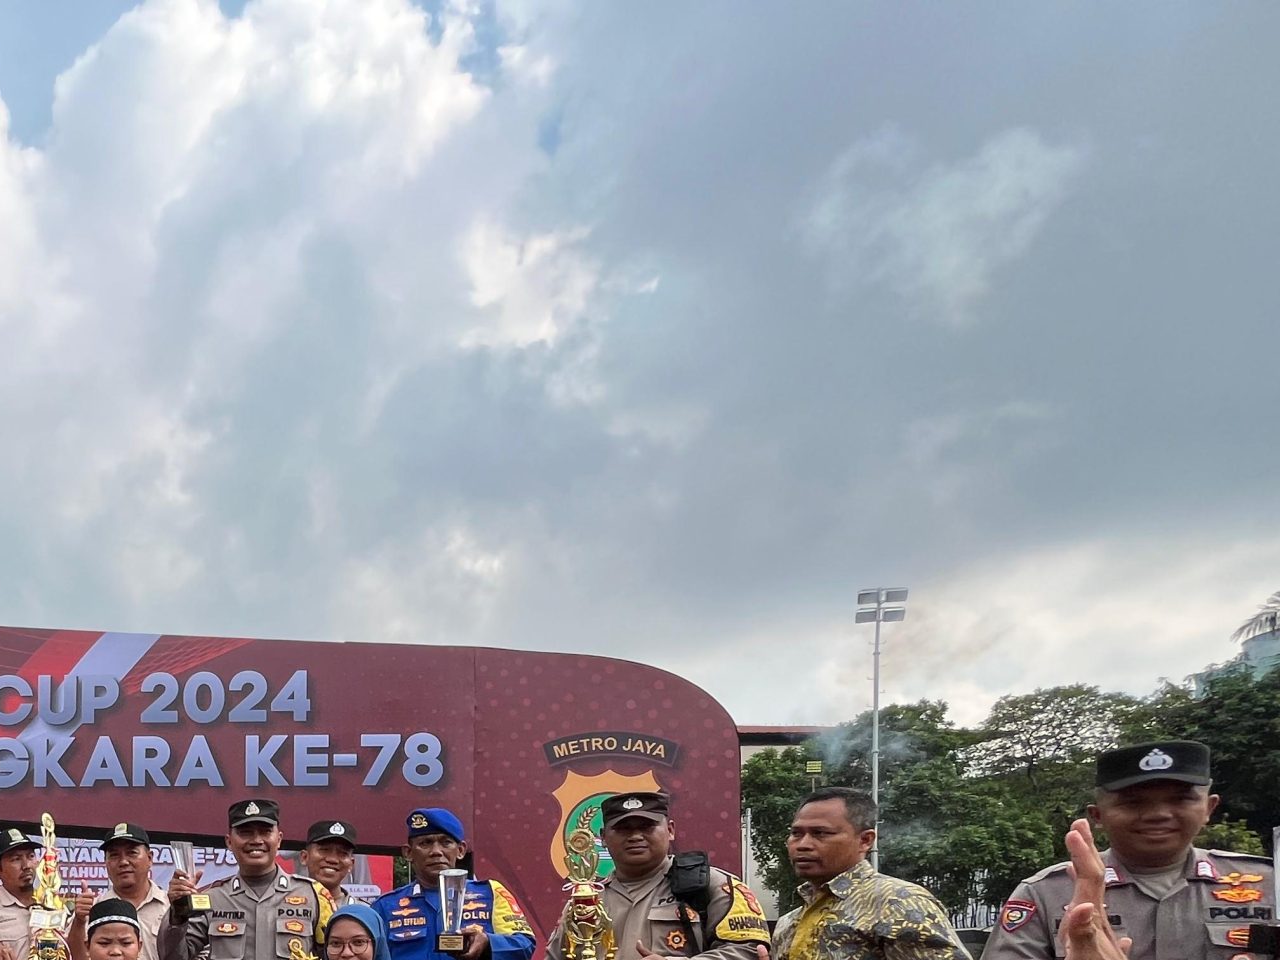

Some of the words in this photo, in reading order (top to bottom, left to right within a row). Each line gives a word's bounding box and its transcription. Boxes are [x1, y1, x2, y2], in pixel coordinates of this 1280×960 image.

[141, 669, 311, 725] 2024
[552, 737, 618, 758] METRO
[622, 738, 666, 758] JAYA
[244, 732, 445, 787] KE-78
[190, 847, 239, 866] E-78
[60, 866, 109, 878] TAHUN
[277, 908, 312, 918] POLRI
[462, 910, 490, 920] OLRI
[1209, 906, 1273, 921] POLRI
